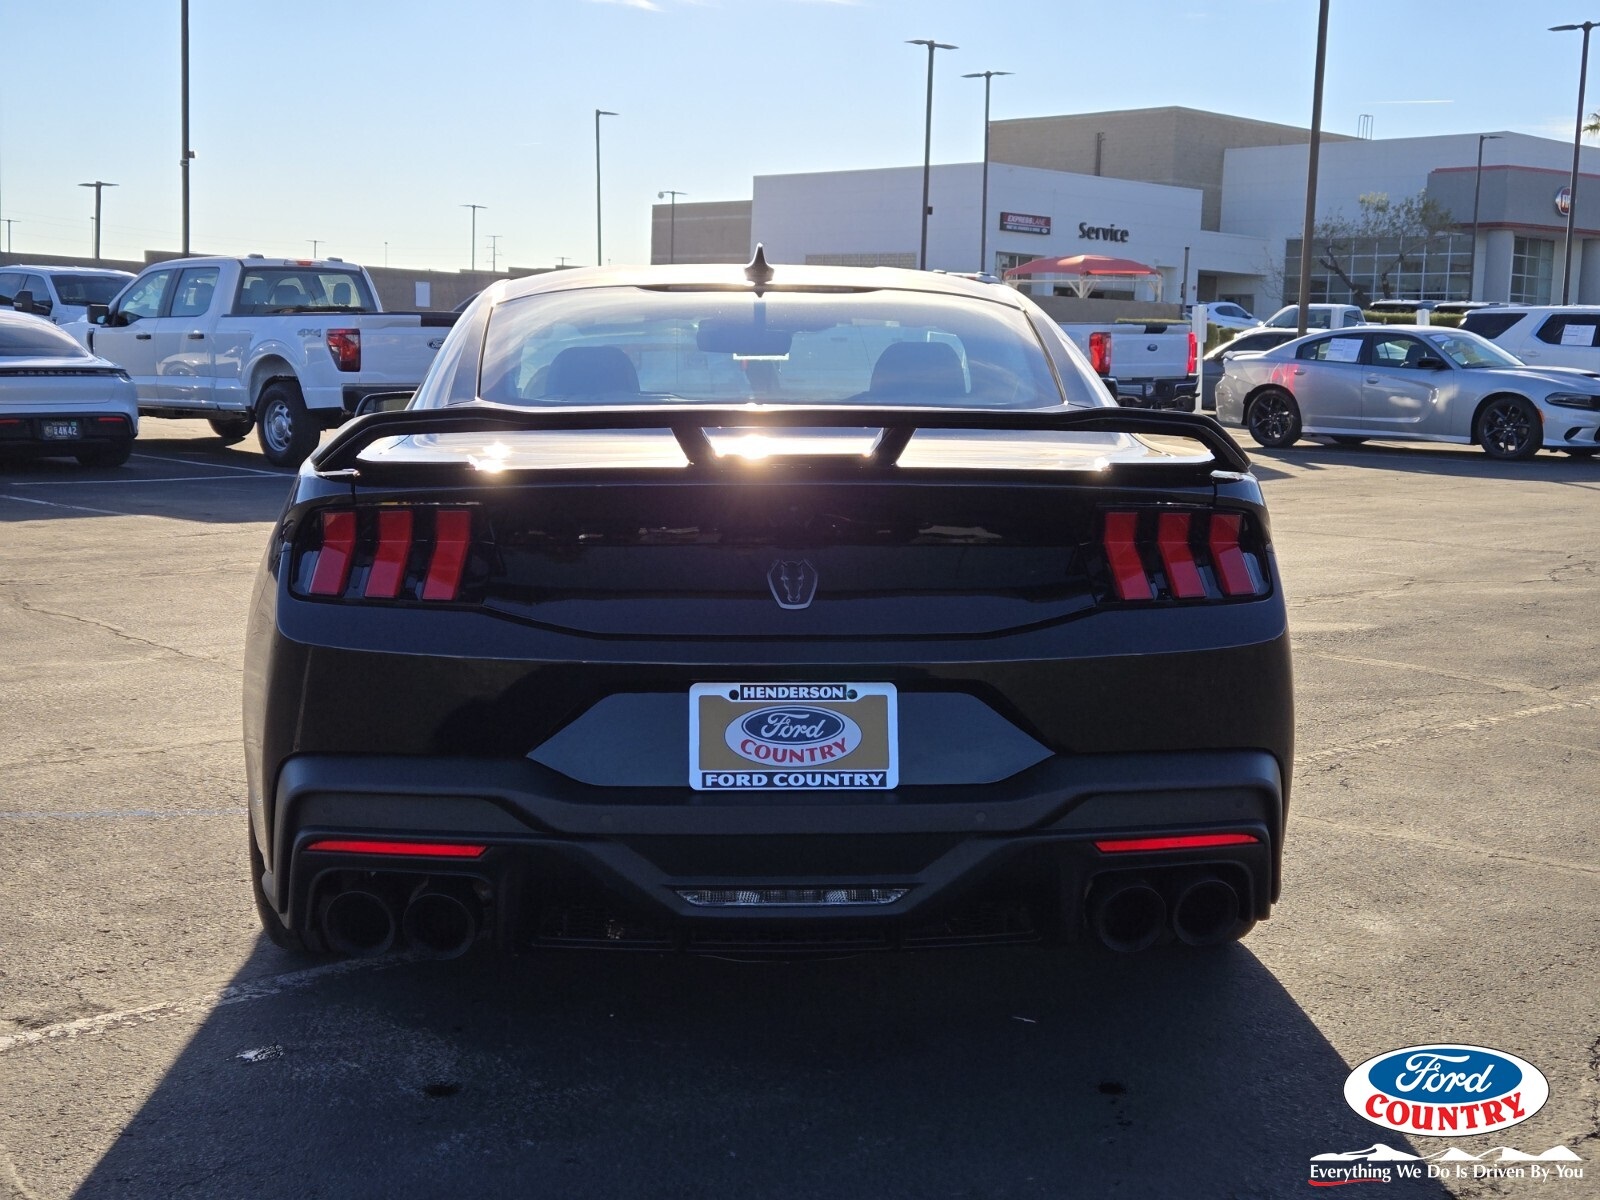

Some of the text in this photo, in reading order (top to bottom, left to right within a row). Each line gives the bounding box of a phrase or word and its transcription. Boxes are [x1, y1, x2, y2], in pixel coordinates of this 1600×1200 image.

[1078, 222, 1129, 243] Service
[743, 686, 844, 699] HENDERSON
[760, 712, 826, 739] Ford
[740, 737, 847, 763] COUNTRY
[705, 773, 884, 787] FORD COUNTRY
